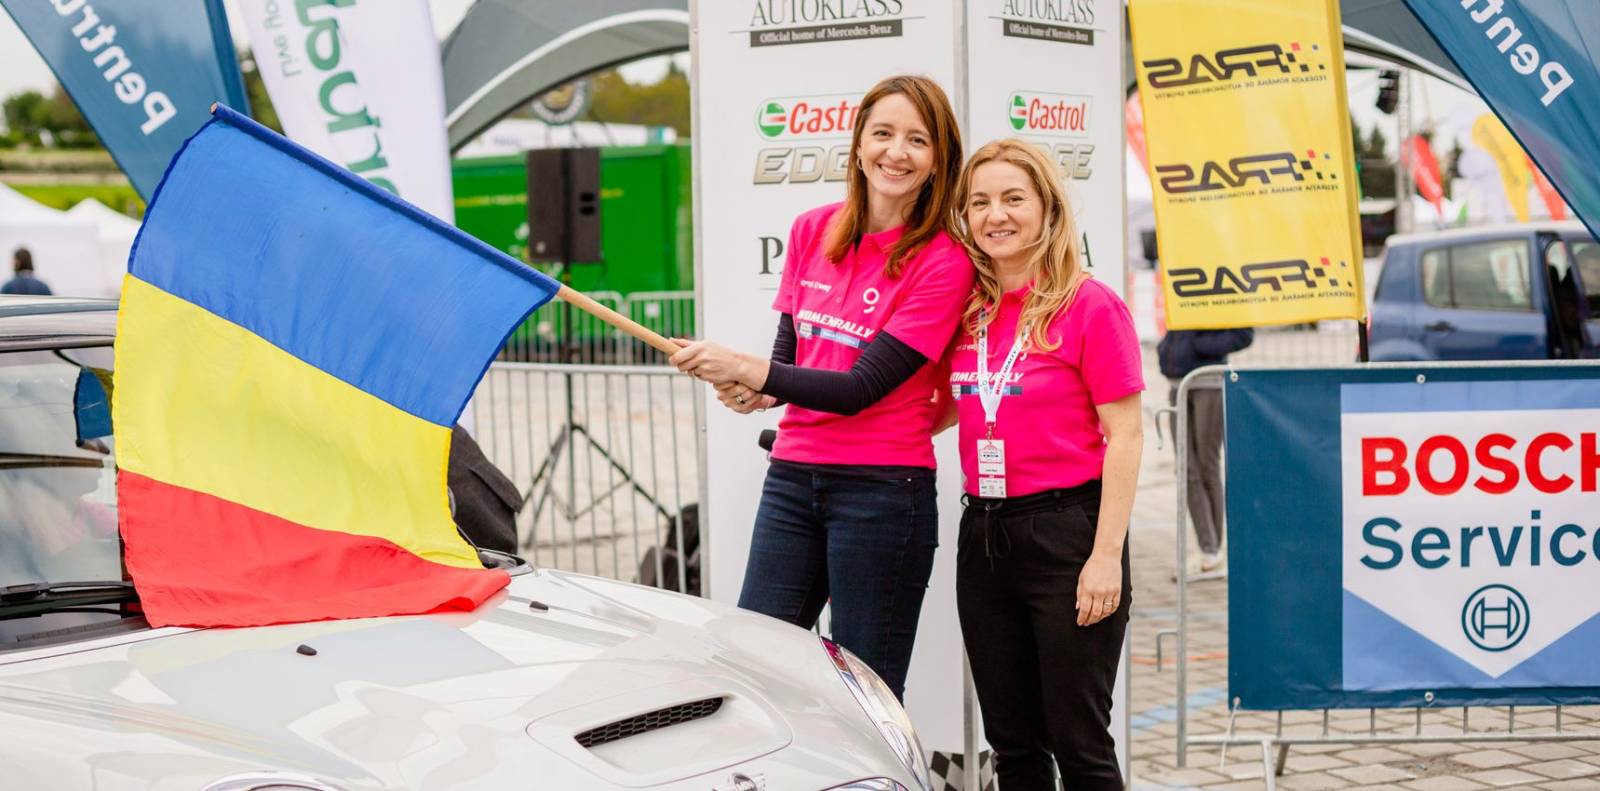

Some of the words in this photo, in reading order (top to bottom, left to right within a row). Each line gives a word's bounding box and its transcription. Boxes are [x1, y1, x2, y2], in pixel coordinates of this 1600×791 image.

[759, 31, 790, 43] Official
[791, 30, 815, 41] home
[816, 29, 826, 39] of
[827, 24, 892, 38] Mercedes-Benz
[789, 102, 861, 134] Castr
[1029, 98, 1085, 132] Castrol
[753, 145, 852, 185] EDG
[1360, 509, 1600, 570] Servic
